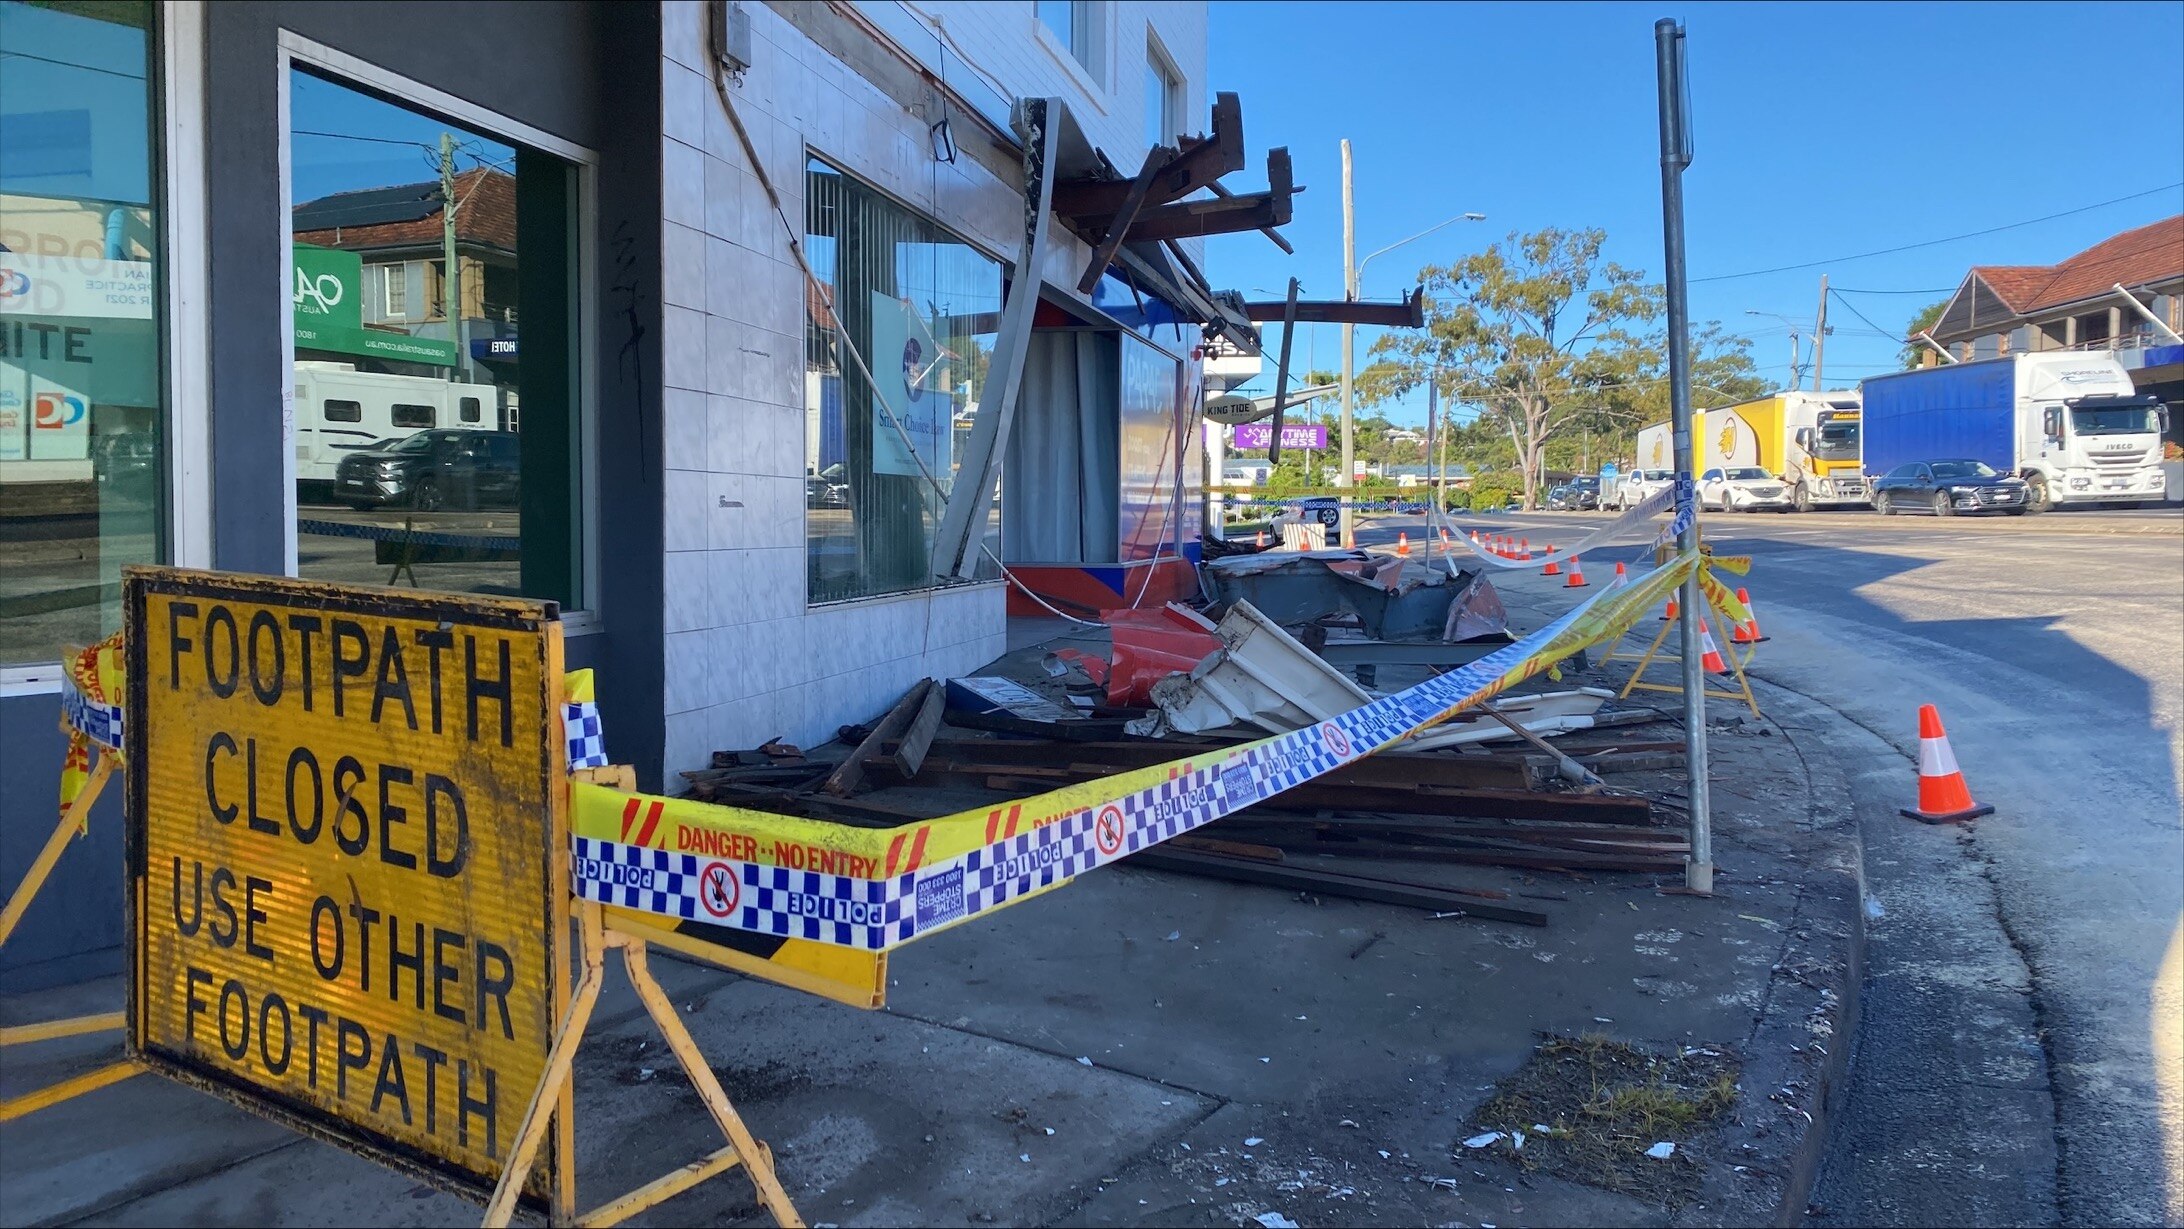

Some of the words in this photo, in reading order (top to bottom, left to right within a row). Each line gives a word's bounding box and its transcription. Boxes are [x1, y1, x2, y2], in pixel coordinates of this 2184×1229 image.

[904, 413, 929, 434] Choice
[1207, 405, 1228, 415] KING
[1231, 403, 1250, 413] TIDE
[168, 601, 513, 748] FOOTPATH
[1267, 746, 1310, 774] POLICE
[205, 731, 470, 879] CLOSED
[1154, 788, 1207, 821] POLICE
[677, 824, 757, 862] DANGER
[576, 858, 653, 888] POLICE
[945, 869, 962, 884] 1800
[996, 842, 1062, 882] POLICE
[918, 880, 932, 893] 000
[918, 883, 962, 910] STOPPERS
[932, 875, 945, 888] 333
[790, 893, 884, 925] POLICE
[932, 895, 962, 916] CRIME
[172, 855, 275, 962] USE
[310, 894, 515, 1042] OTHER
[186, 966, 497, 1159] FOOTPATH
